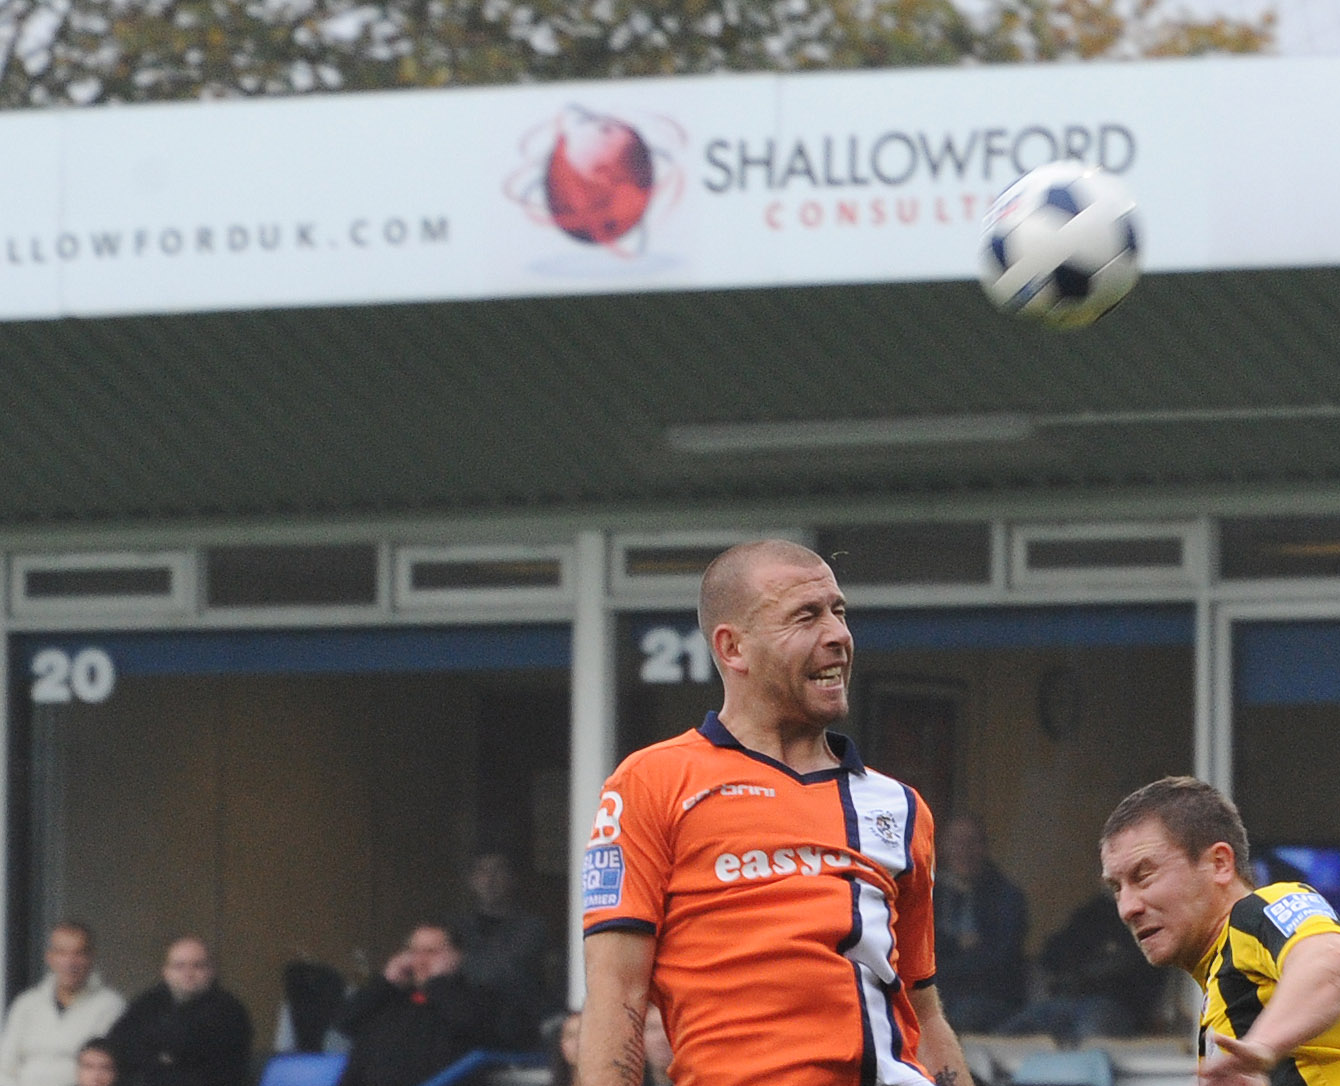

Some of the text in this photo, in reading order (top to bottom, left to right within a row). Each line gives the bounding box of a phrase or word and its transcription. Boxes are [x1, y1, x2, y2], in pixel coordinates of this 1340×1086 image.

[703, 122, 1136, 194] SHALLOWFORD
[765, 196, 982, 230] CONSULT
[31, 647, 116, 703] 20
[640, 626, 713, 684] 21
